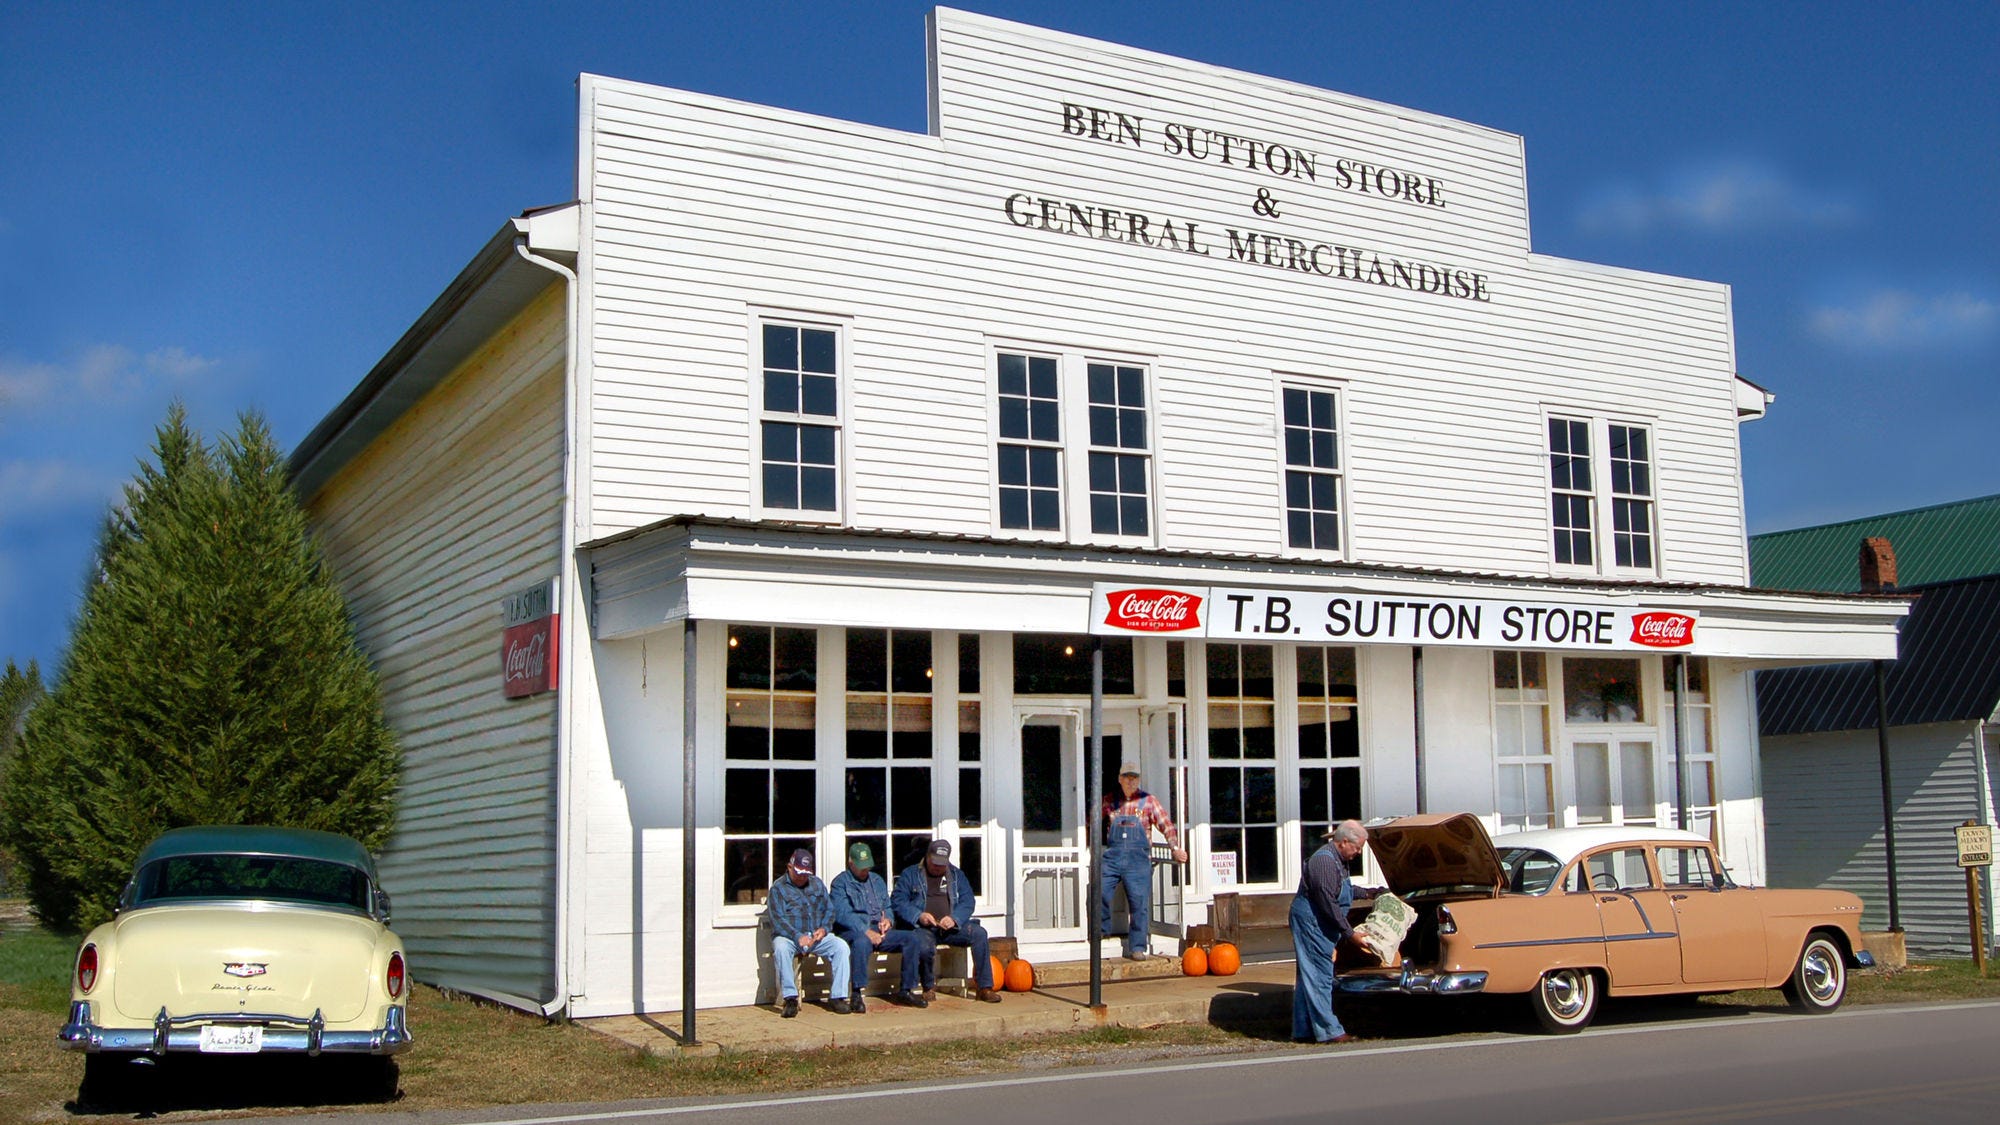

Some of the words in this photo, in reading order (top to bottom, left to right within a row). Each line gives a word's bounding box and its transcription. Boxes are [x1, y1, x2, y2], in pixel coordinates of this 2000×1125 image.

[1060, 102, 1144, 148] BEN
[1164, 122, 1317, 183] SUTTON
[1336, 159, 1446, 208] STORE
[1252, 187, 1281, 219] &
[1004, 192, 1210, 256] GENERAL
[1225, 228, 1491, 302] MERCHANDISE
[1226, 593, 1301, 635] T.B.
[1325, 598, 1482, 641] SUTTON
[1500, 605, 1616, 645] STORE
